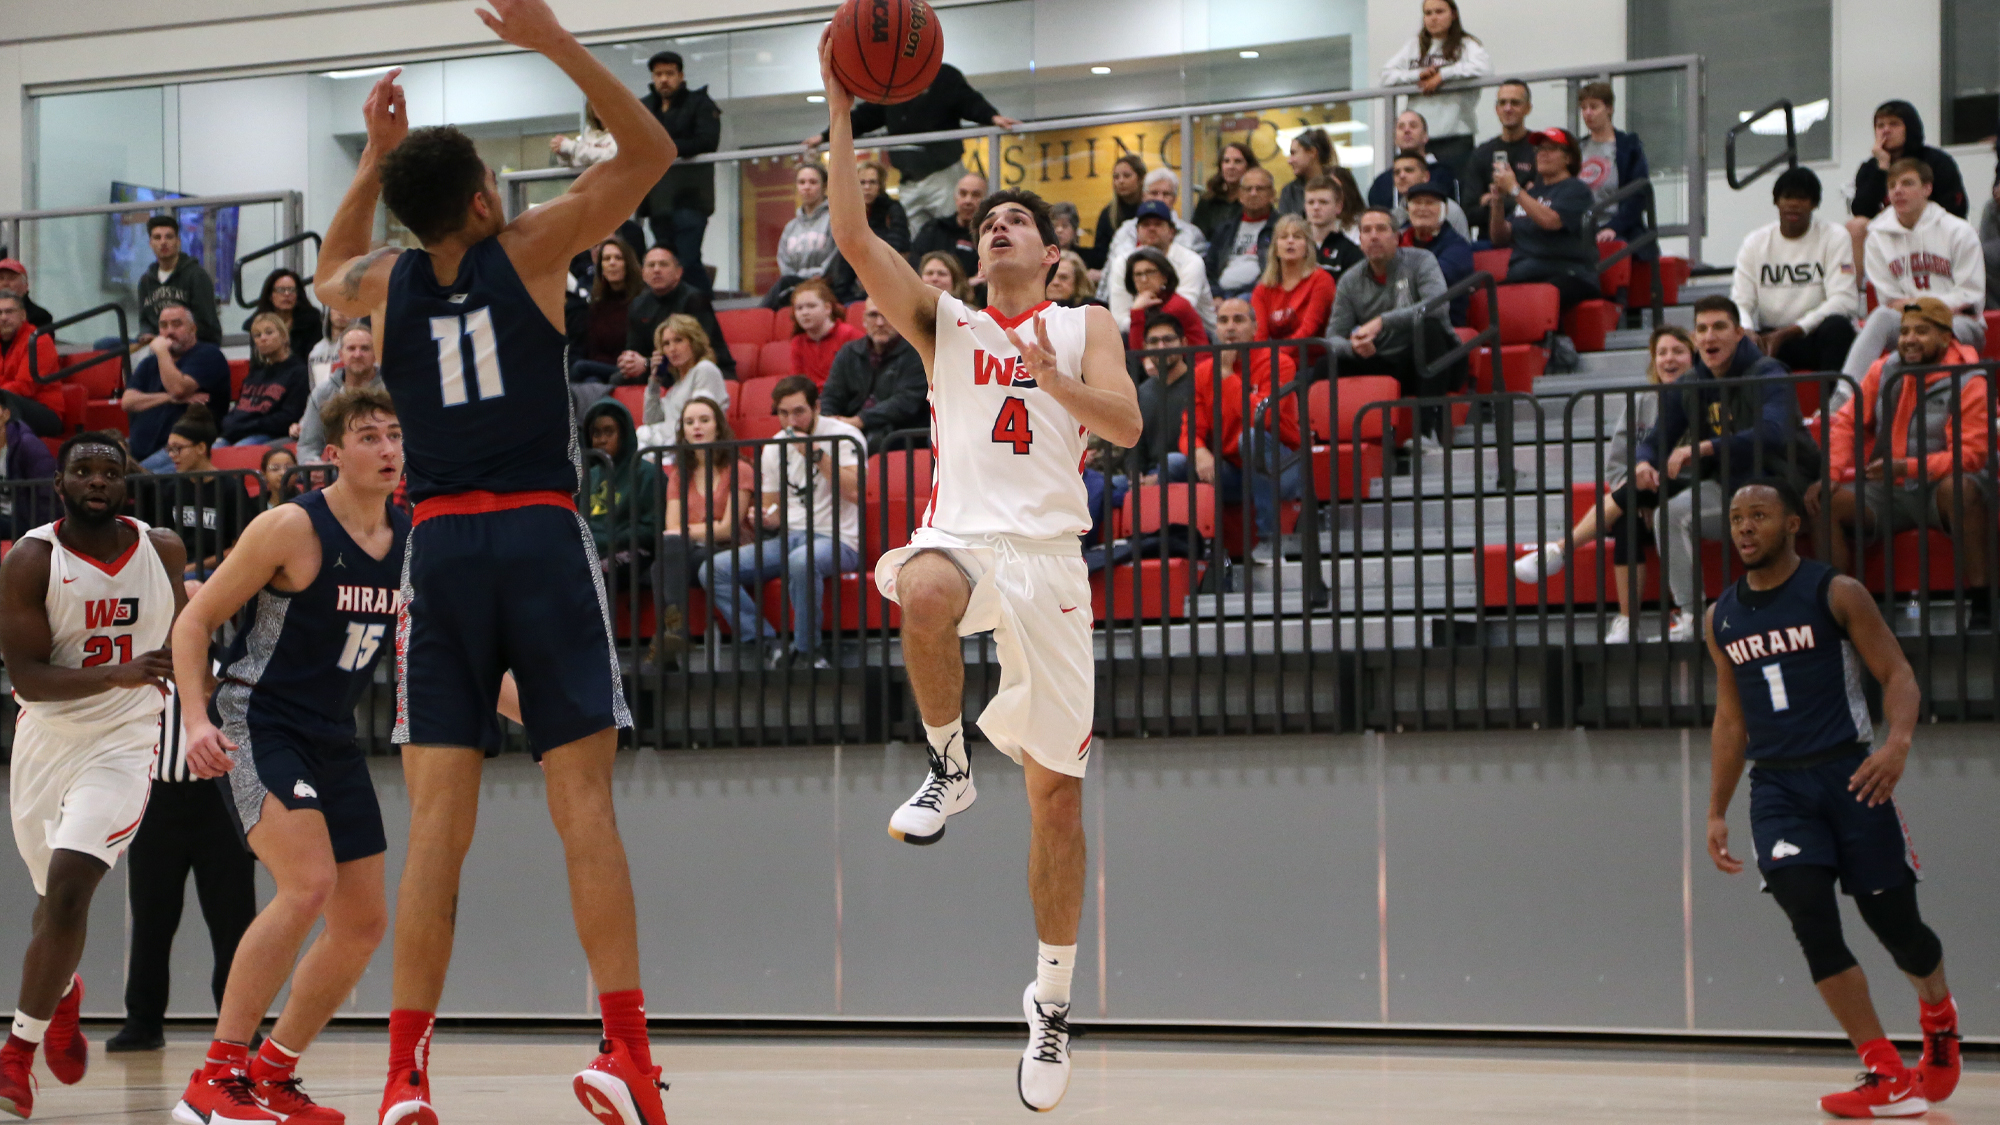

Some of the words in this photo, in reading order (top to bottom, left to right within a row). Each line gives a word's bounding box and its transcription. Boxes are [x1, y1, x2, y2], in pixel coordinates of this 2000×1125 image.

[1760, 262, 1824, 285] NASA
[428, 305, 505, 408] 11
[992, 396, 1033, 455] 4
[85, 598, 139, 629] W&J
[82, 634, 132, 668] 21
[336, 620, 386, 672] 15
[1725, 625, 1815, 665] HIRAM
[1762, 662, 1789, 712] 1
